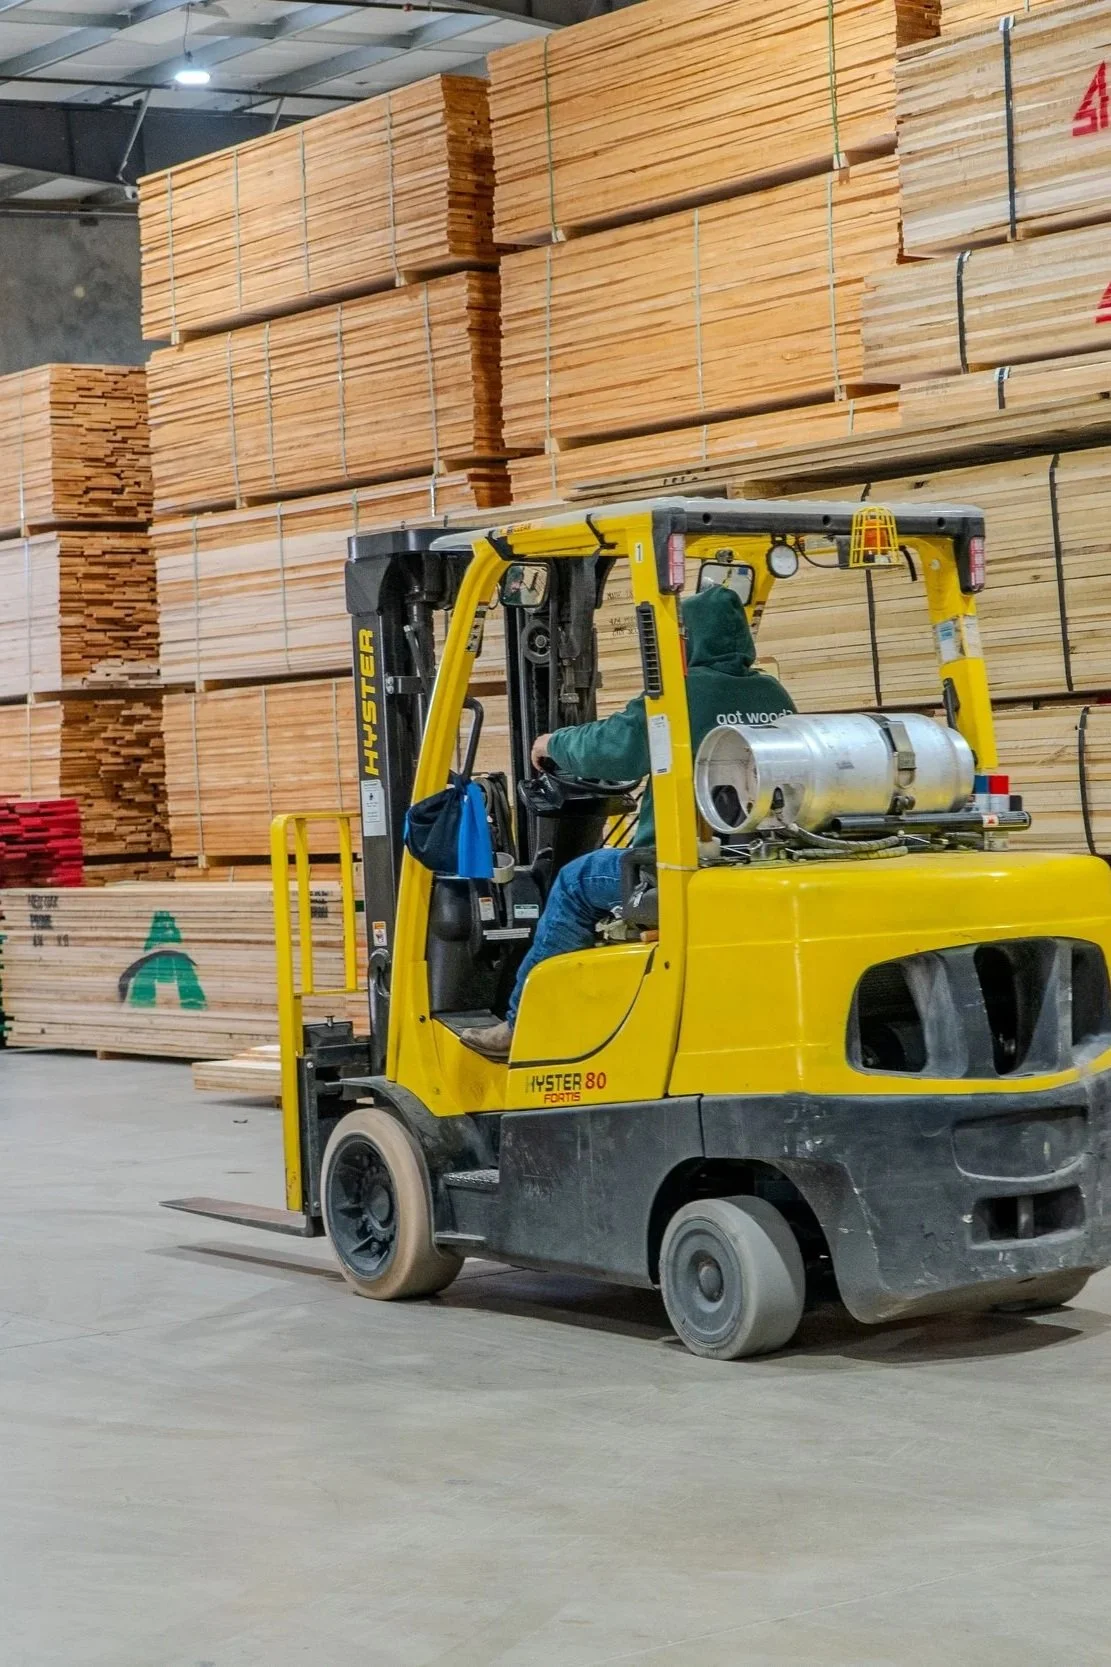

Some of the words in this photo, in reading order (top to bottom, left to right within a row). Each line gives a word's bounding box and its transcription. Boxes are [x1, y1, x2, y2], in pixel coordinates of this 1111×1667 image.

[358, 628, 380, 776] HYSTER
[716, 710, 744, 725] got
[525, 1073, 581, 1093] HYSTER
[585, 1071, 607, 1089] 80
[544, 1092, 580, 1103] FORTIS
